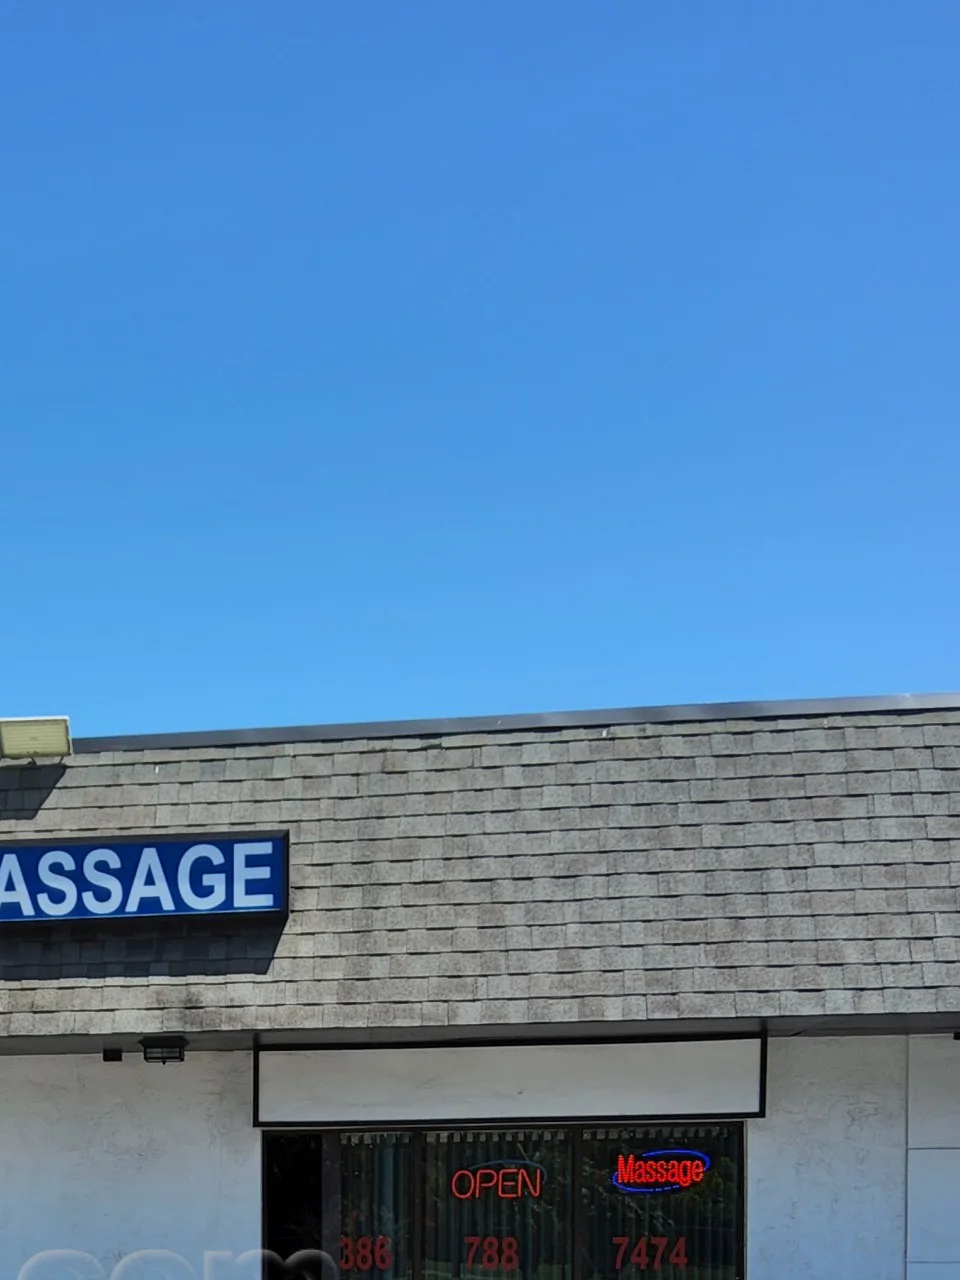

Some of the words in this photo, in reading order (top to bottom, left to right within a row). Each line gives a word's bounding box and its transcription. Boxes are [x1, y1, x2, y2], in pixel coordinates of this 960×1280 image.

[451, 1168, 541, 1198] OPEN
[617, 1154, 704, 1187] Massage
[339, 1236, 392, 1271] 386
[464, 1236, 519, 1271] 788
[613, 1236, 688, 1271] 7474
